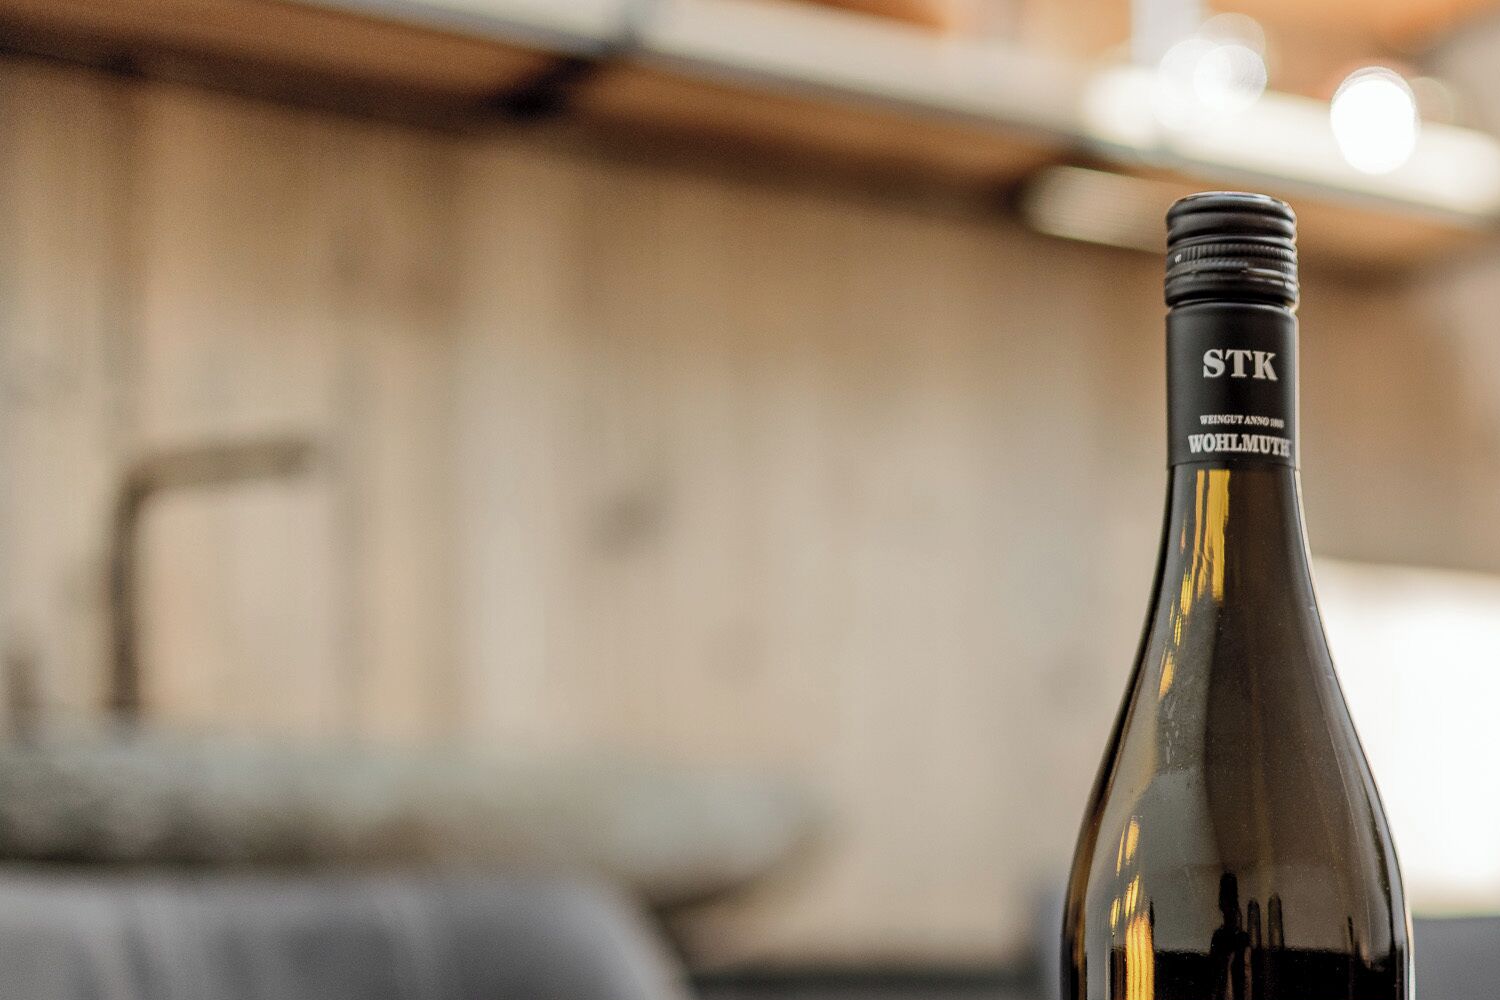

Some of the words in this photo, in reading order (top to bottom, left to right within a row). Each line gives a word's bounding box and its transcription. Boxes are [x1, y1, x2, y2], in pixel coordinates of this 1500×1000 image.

[1202, 348, 1279, 381] STK
[1200, 414, 1244, 425] WEINGUT
[1244, 415, 1270, 427] ANNO
[1187, 433, 1291, 458] WOHLMUTH
